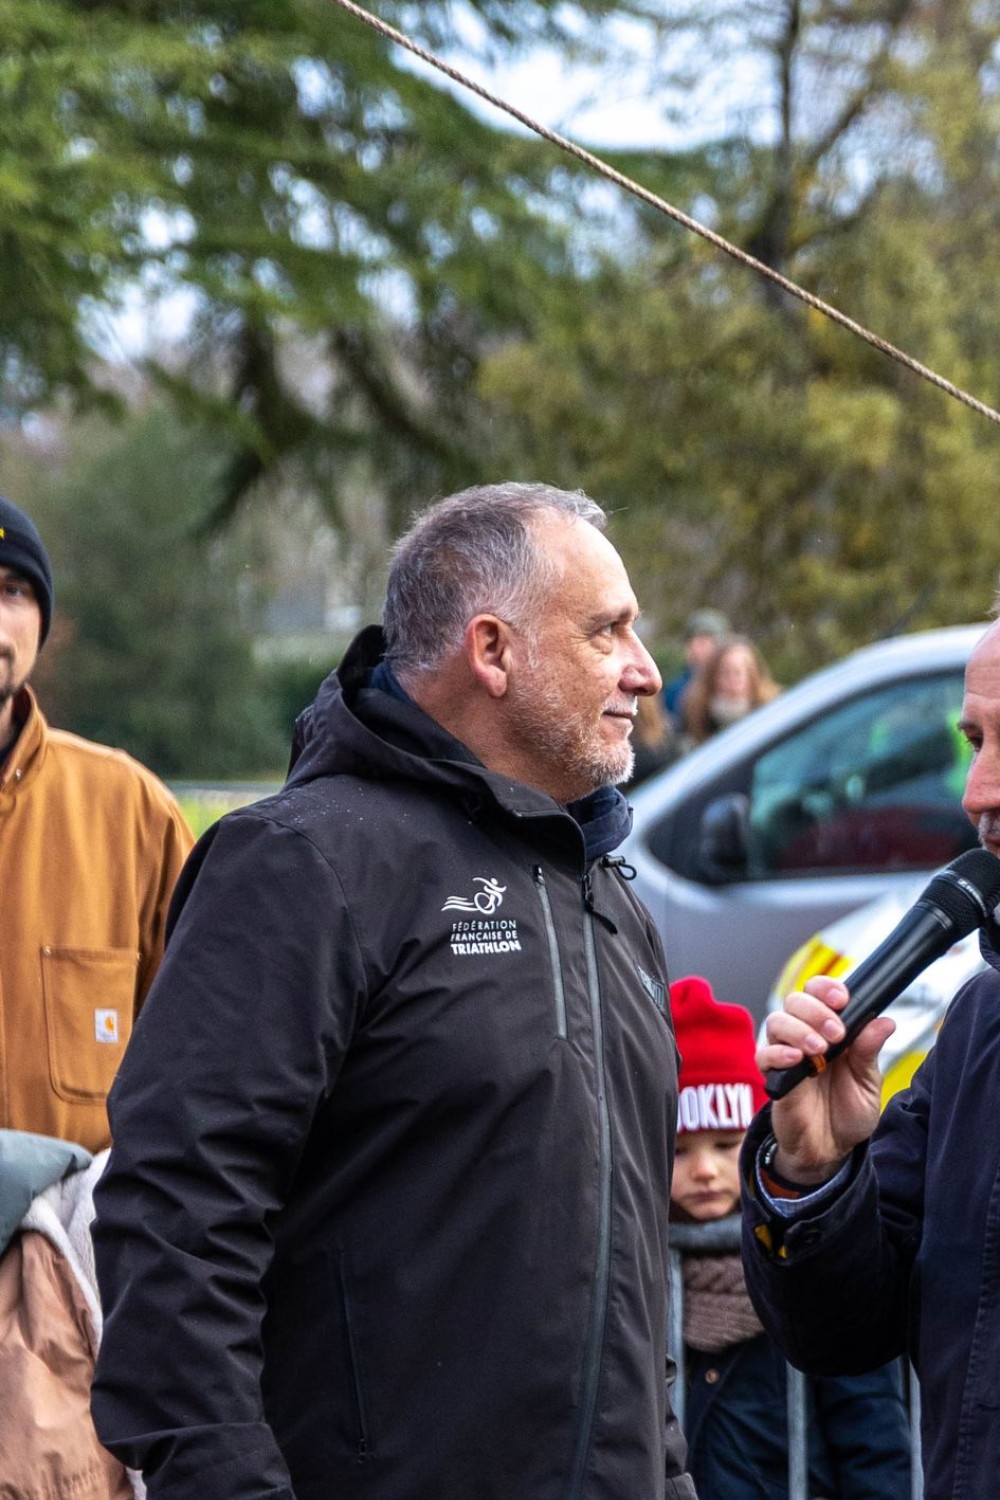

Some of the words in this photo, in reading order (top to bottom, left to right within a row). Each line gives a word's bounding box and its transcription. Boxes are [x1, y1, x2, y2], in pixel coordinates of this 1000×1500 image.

[452, 920, 517, 932] FÉDÉRATION
[450, 931, 502, 942] FRANÇAISE
[505, 930, 518, 940] DE
[450, 940, 522, 955] TRIATHLON
[676, 1083, 754, 1132] OKLYN
